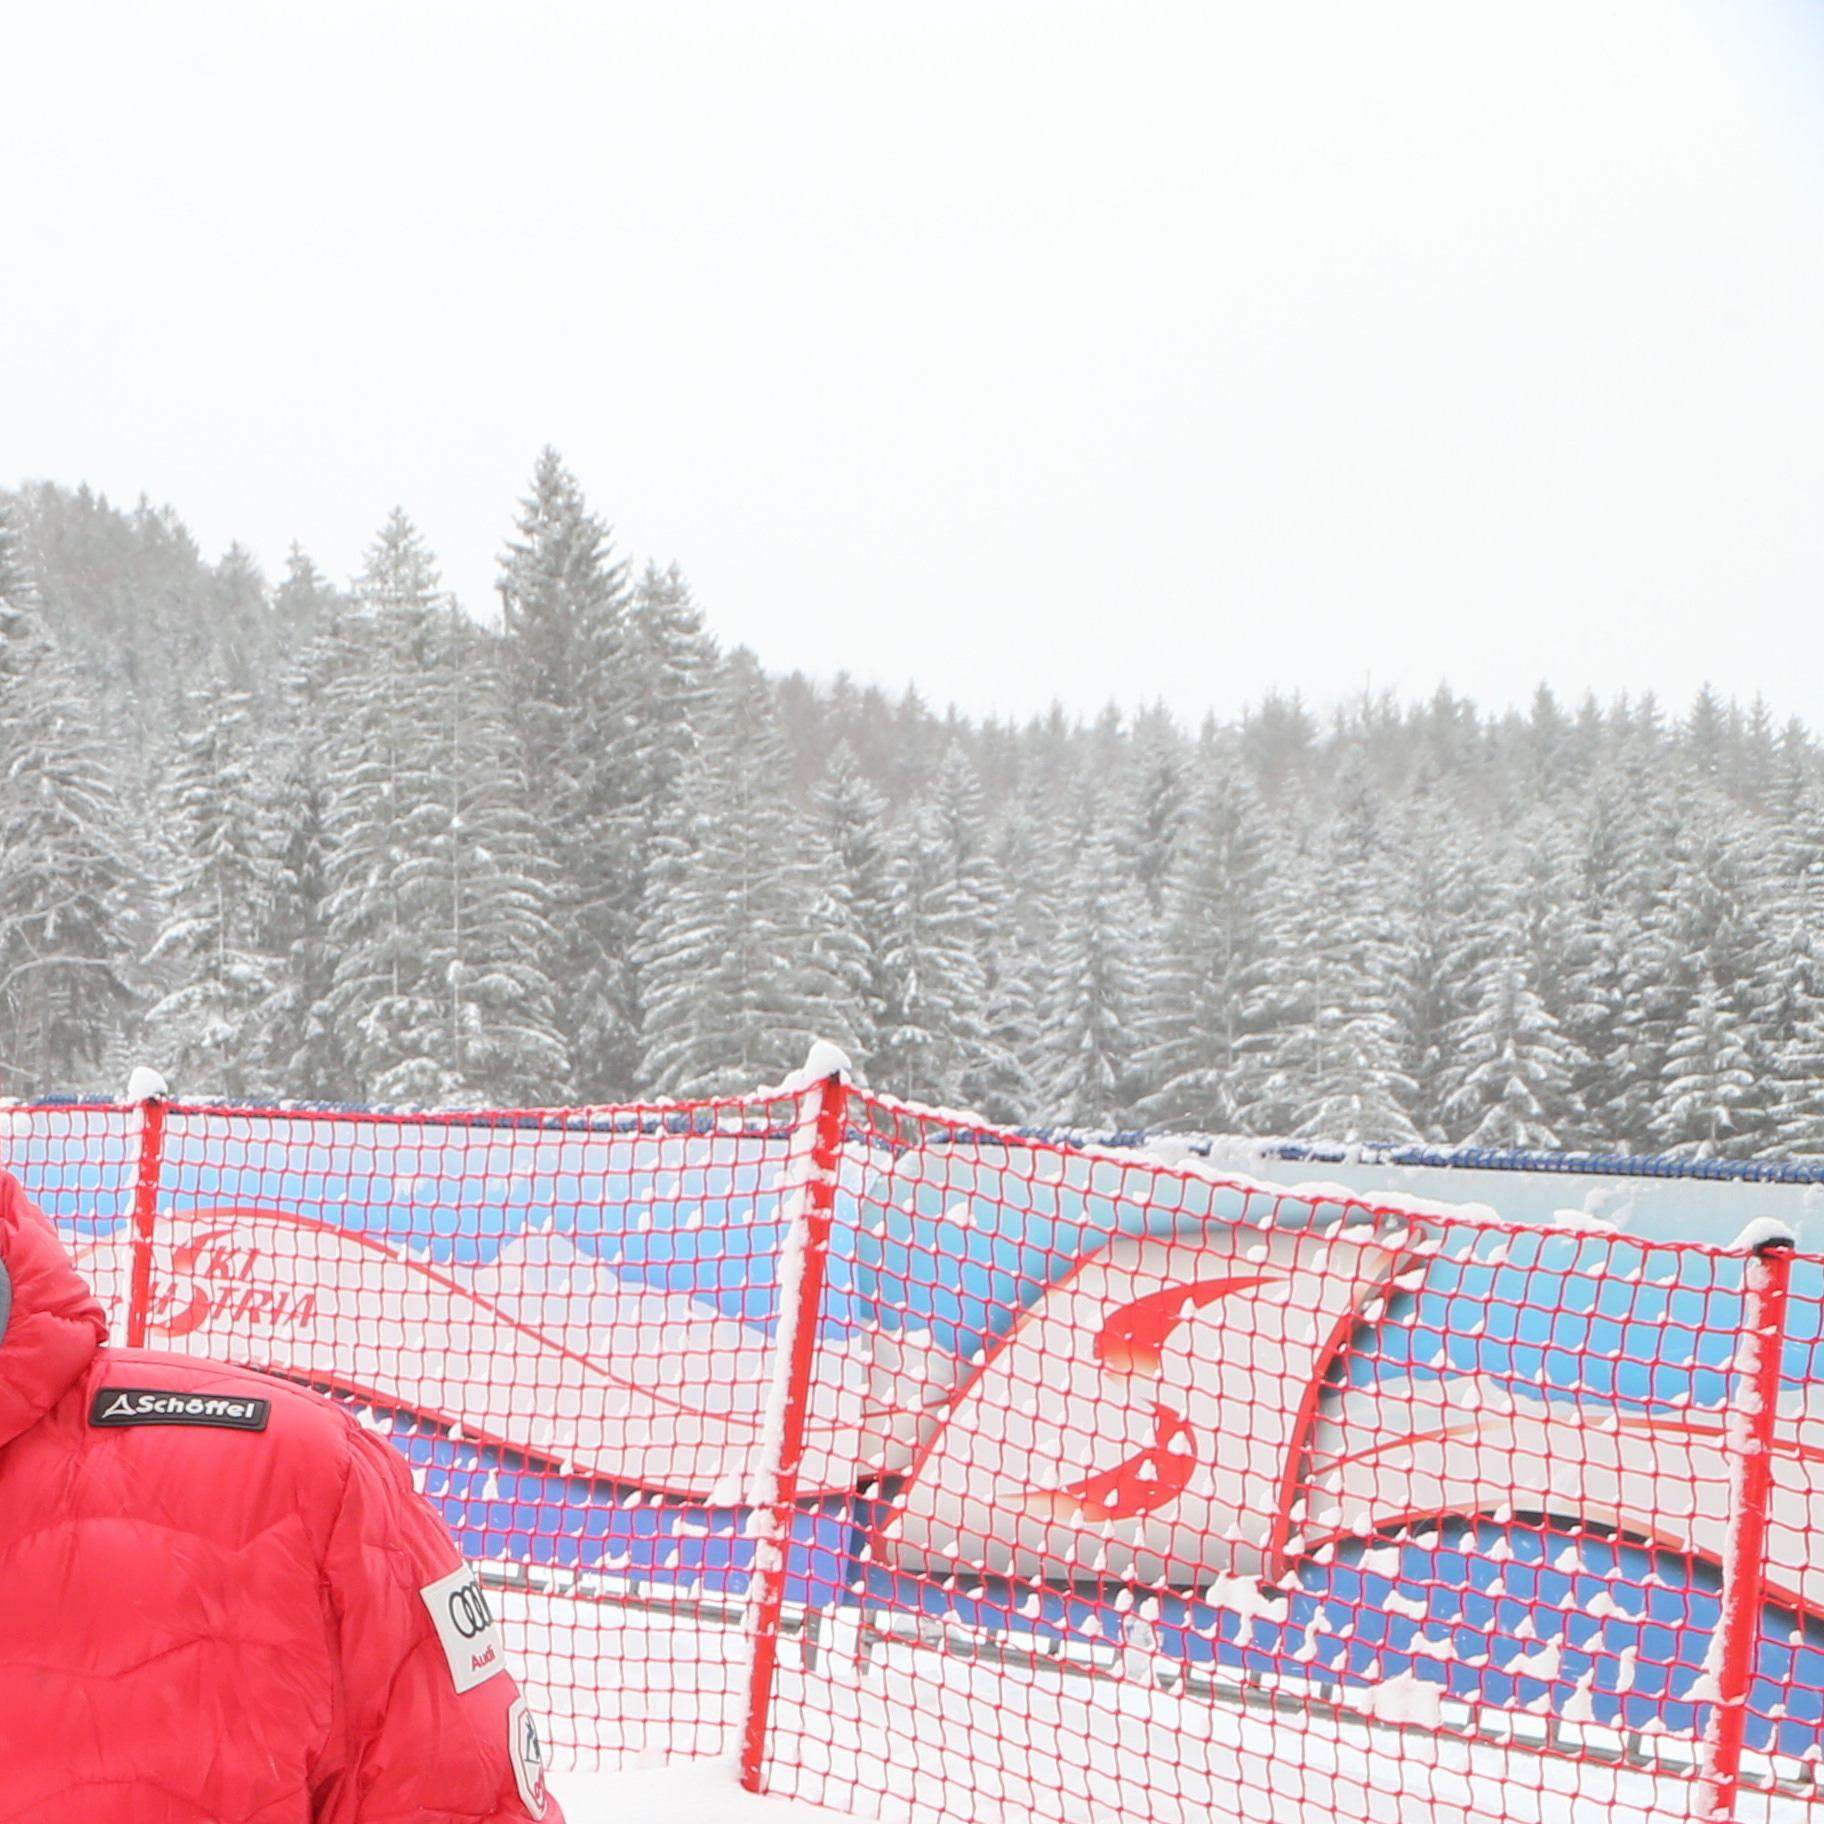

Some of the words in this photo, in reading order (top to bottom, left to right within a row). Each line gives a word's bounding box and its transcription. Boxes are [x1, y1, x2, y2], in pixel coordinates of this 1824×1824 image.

[149, 1281, 316, 1338] USTRIA
[136, 1395, 255, 1419] Schöffel
[471, 1645, 496, 1672] Audi
